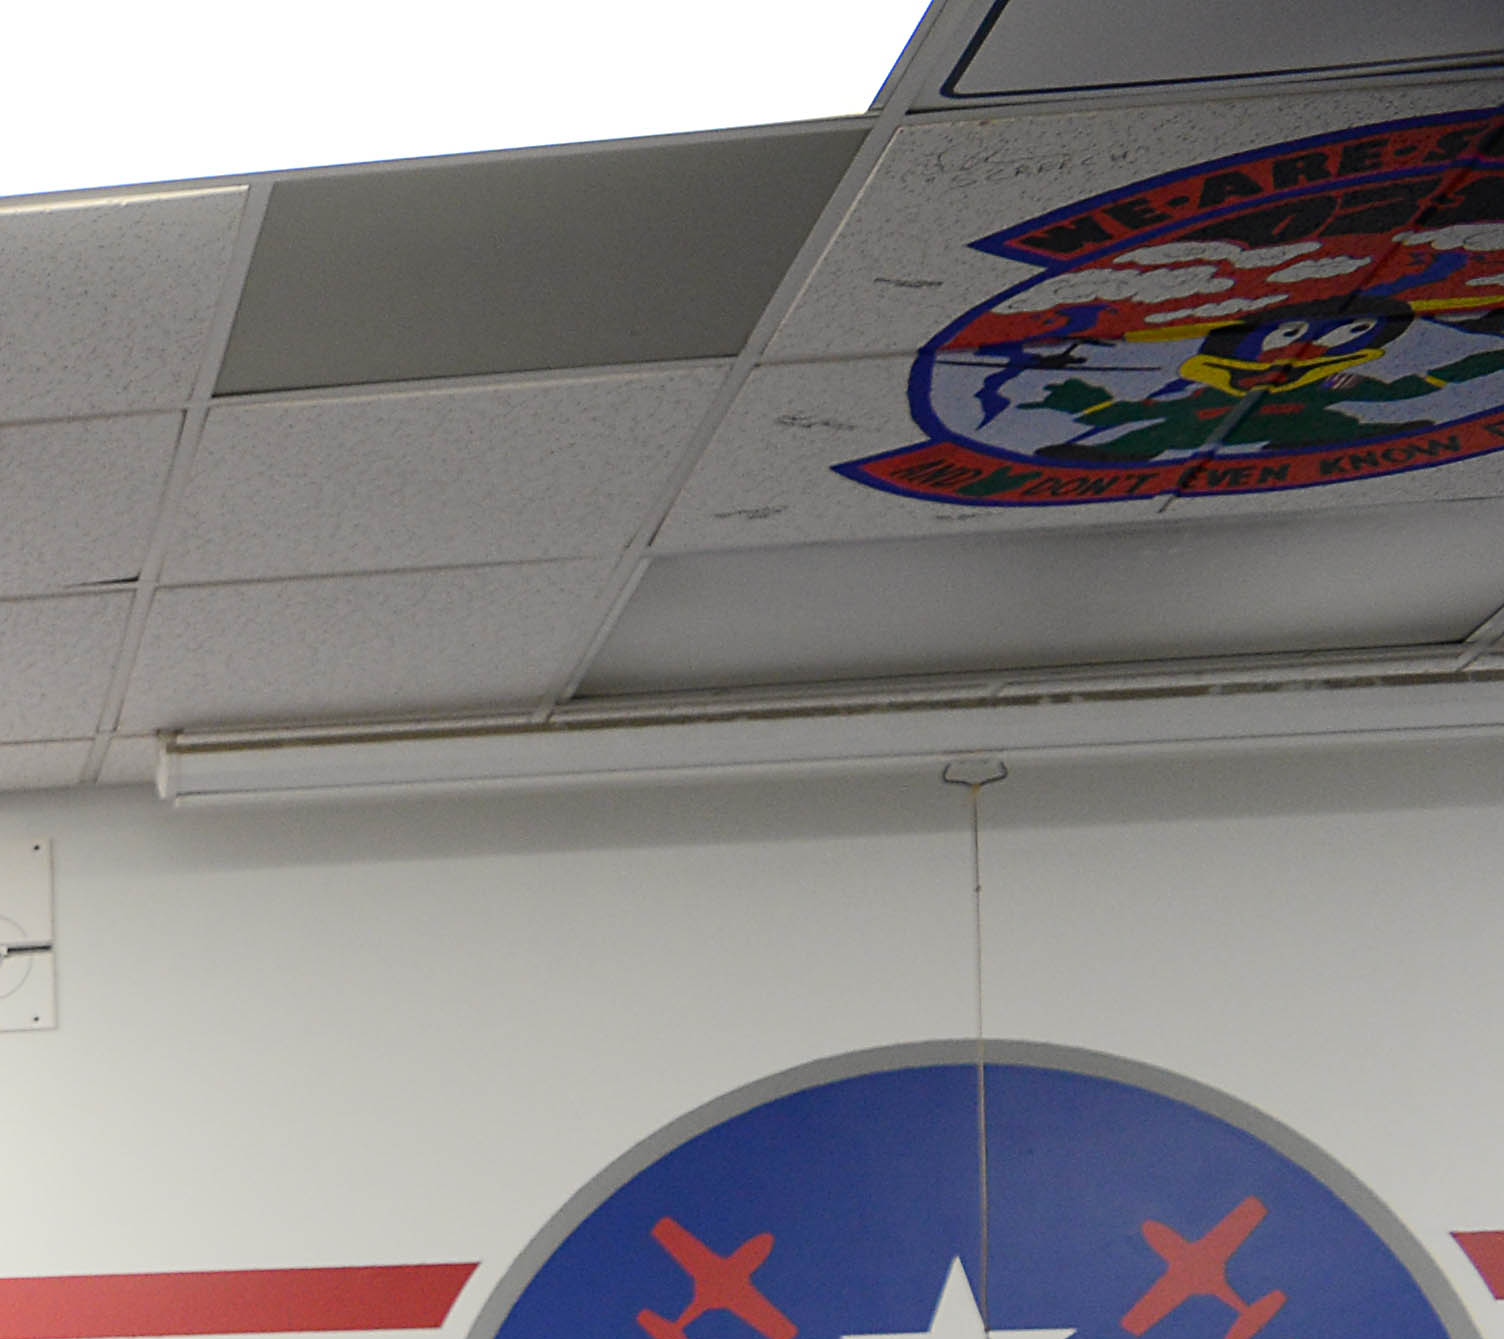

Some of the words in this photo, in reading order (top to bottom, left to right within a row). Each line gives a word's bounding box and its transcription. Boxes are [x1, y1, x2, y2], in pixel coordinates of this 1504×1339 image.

[1198, 137, 1389, 210] ARE
[1020, 471, 1160, 498] DON'T
[1319, 434, 1461, 479] KNOW
